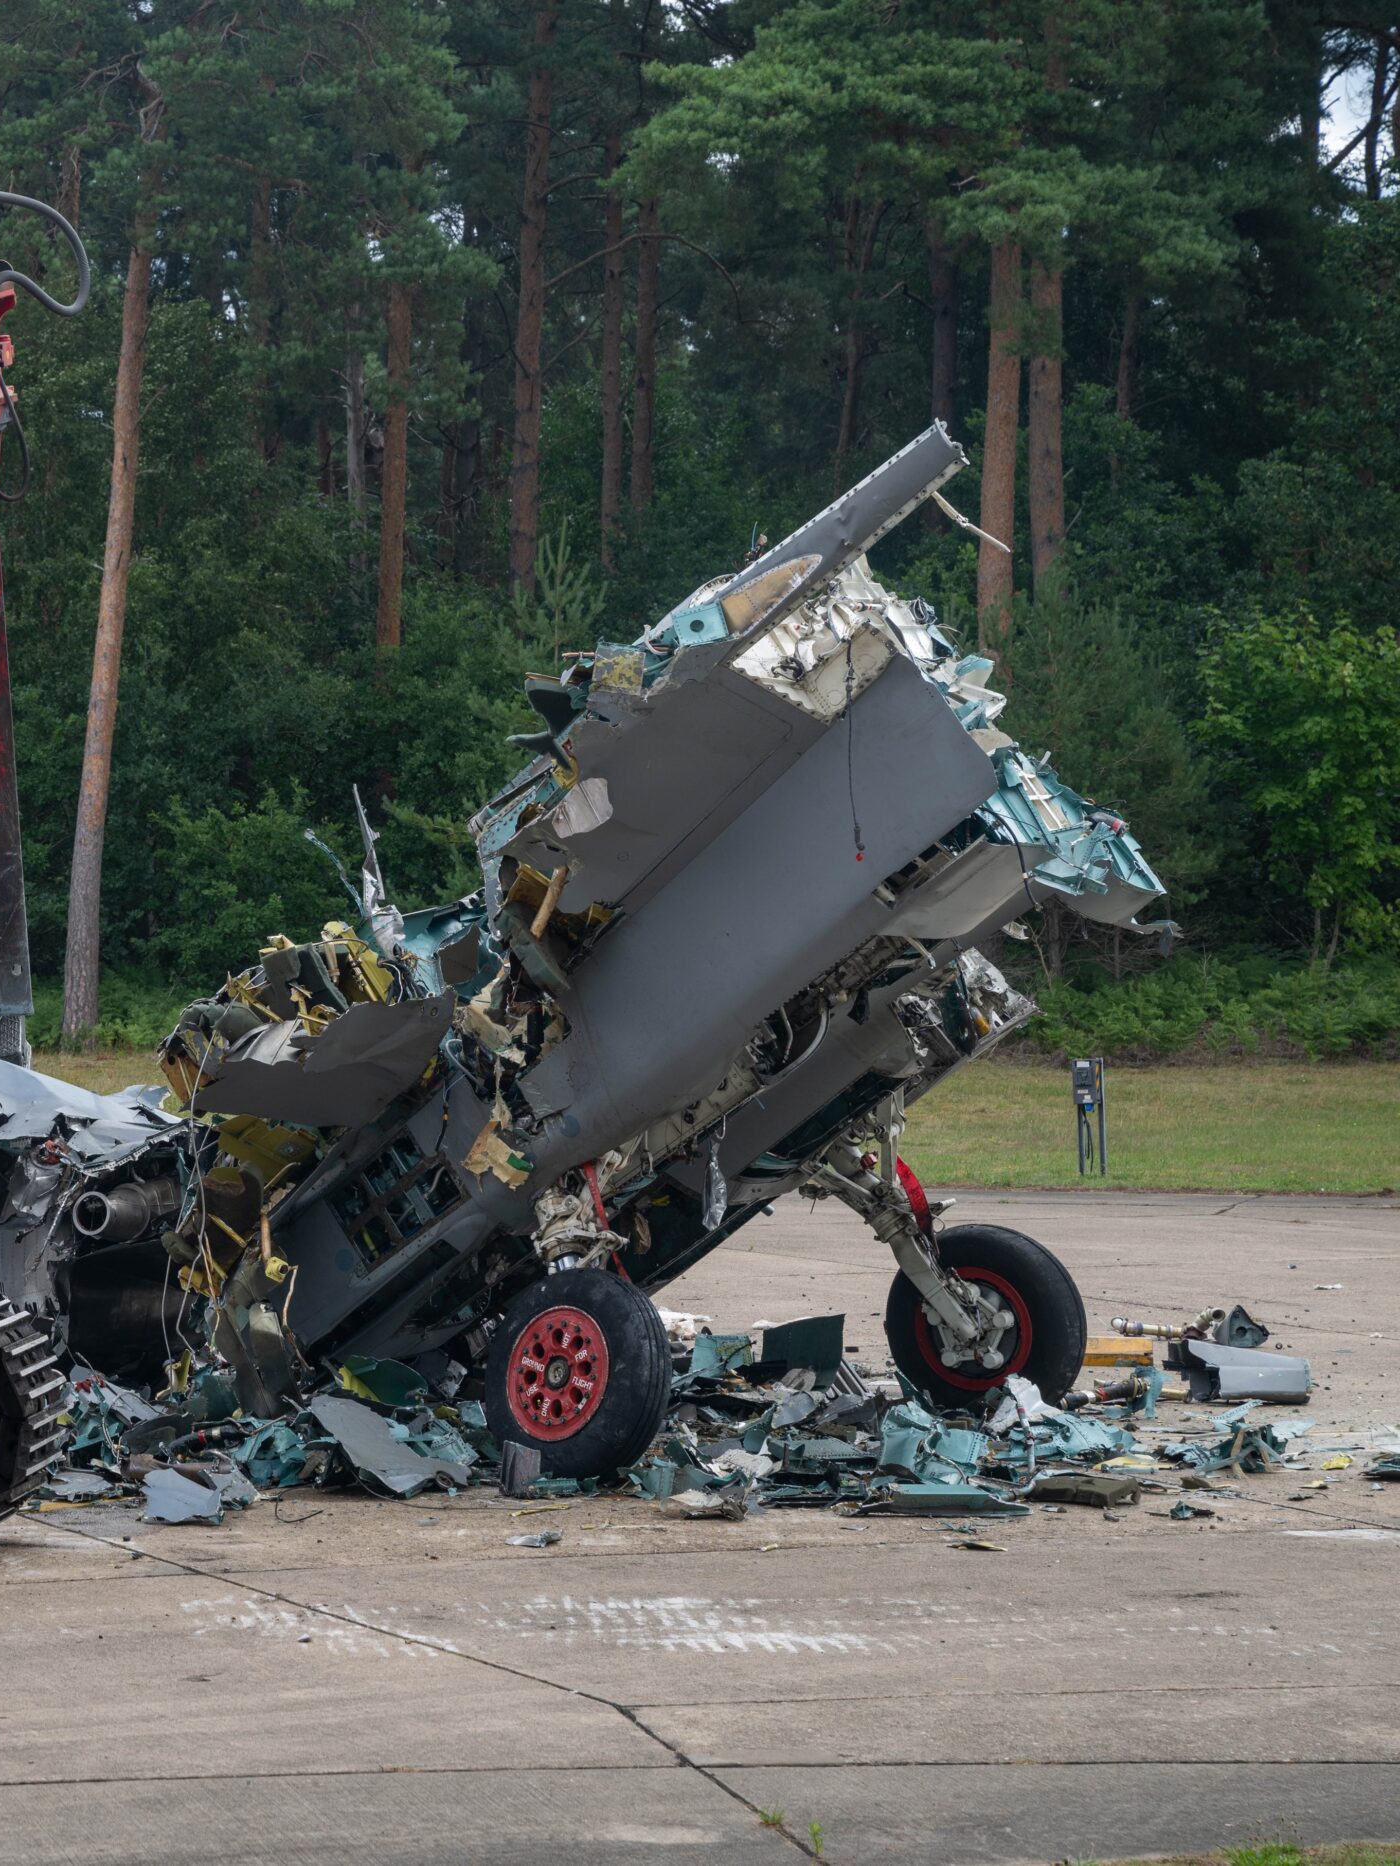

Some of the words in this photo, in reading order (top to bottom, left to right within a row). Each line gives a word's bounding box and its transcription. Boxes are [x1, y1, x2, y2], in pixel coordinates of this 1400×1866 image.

[561, 1332, 571, 1349] NOT
[575, 1349, 588, 1361] FOR
[521, 1356, 545, 1372] GROUND
[526, 1383, 539, 1397] USE
[572, 1376, 593, 1390] FLIGHT
[541, 1397, 550, 1417] ONLY
